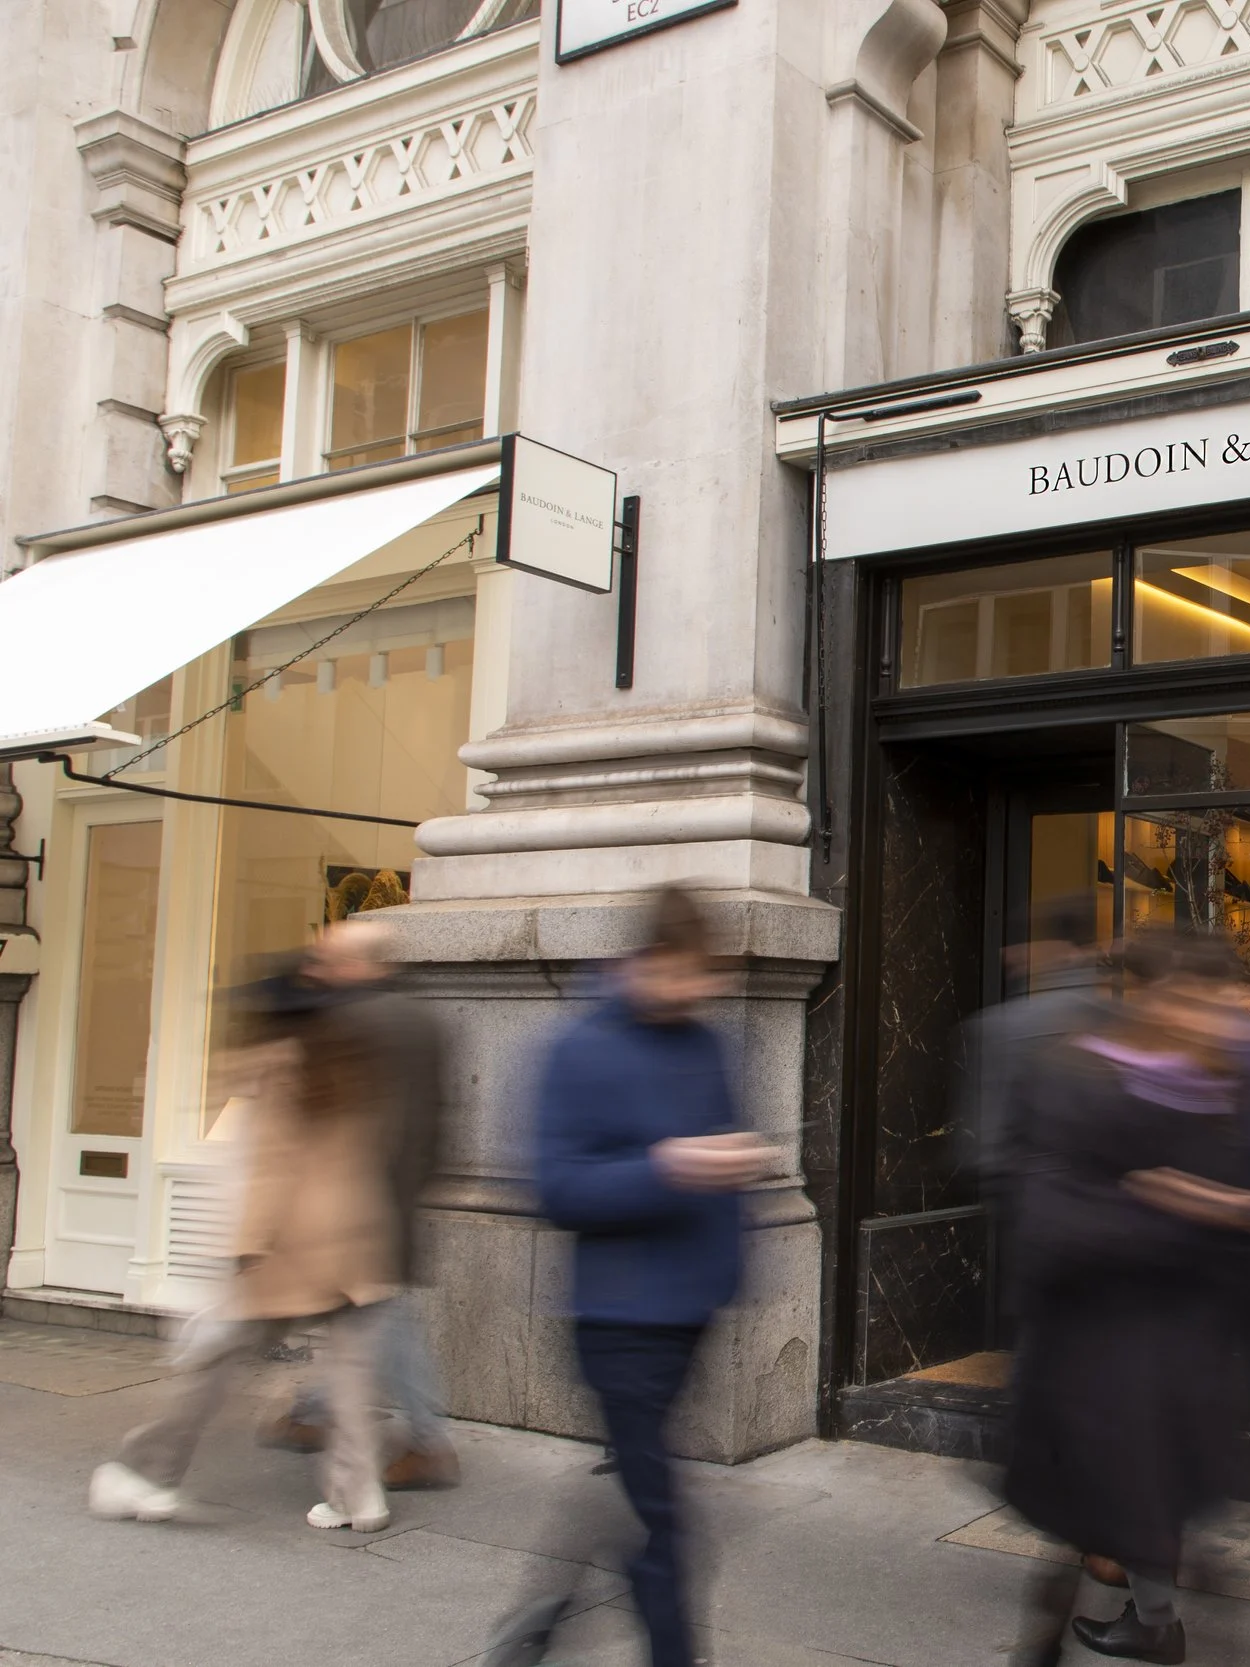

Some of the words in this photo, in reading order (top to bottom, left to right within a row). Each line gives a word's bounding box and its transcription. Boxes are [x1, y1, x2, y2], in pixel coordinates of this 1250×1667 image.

[627, 0, 659, 22] EC2
[1028, 437, 1209, 496] BAUDOIN
[520, 491, 564, 515] BAUDOIN
[565, 509, 572, 518] &
[574, 511, 604, 530] LANGE
